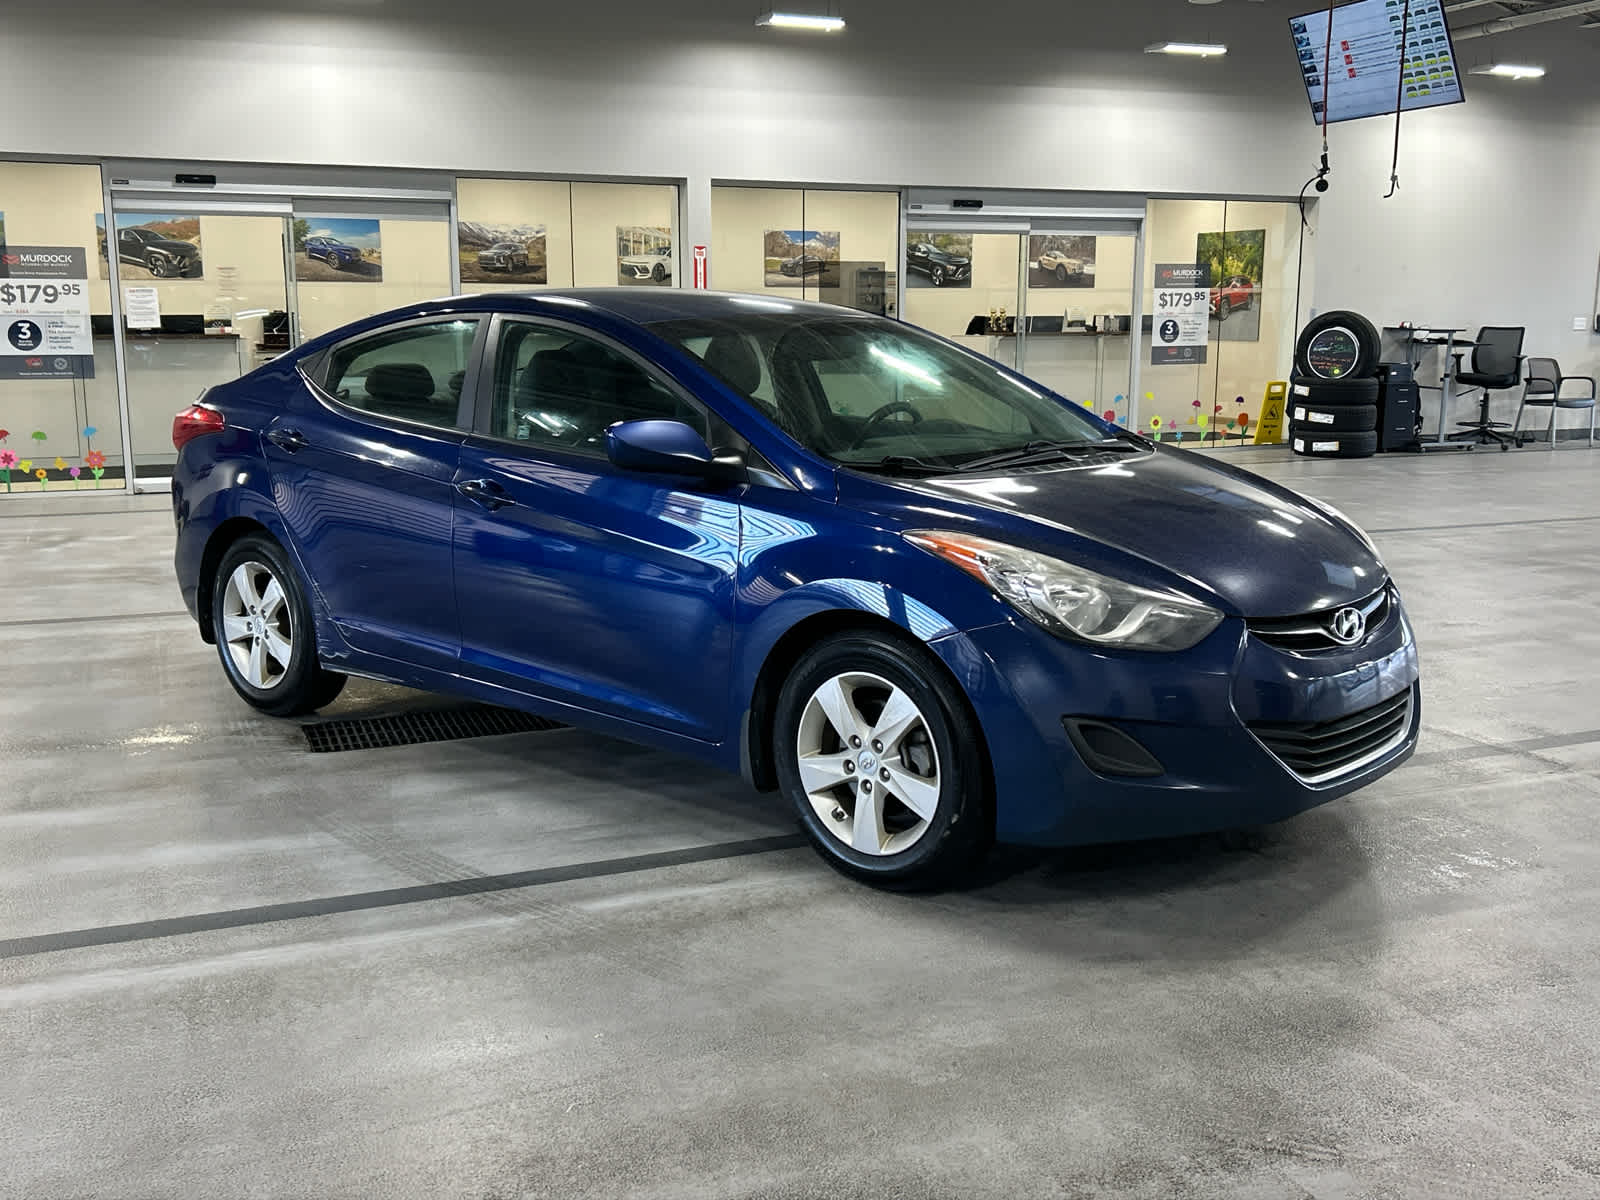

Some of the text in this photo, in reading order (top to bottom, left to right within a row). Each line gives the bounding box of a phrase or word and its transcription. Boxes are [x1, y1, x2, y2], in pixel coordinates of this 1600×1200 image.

[20, 254, 72, 263] MURDOCK
[0, 283, 80, 306] $179.95
[18, 322, 32, 339] 3
[1165, 321, 1174, 334] 3
